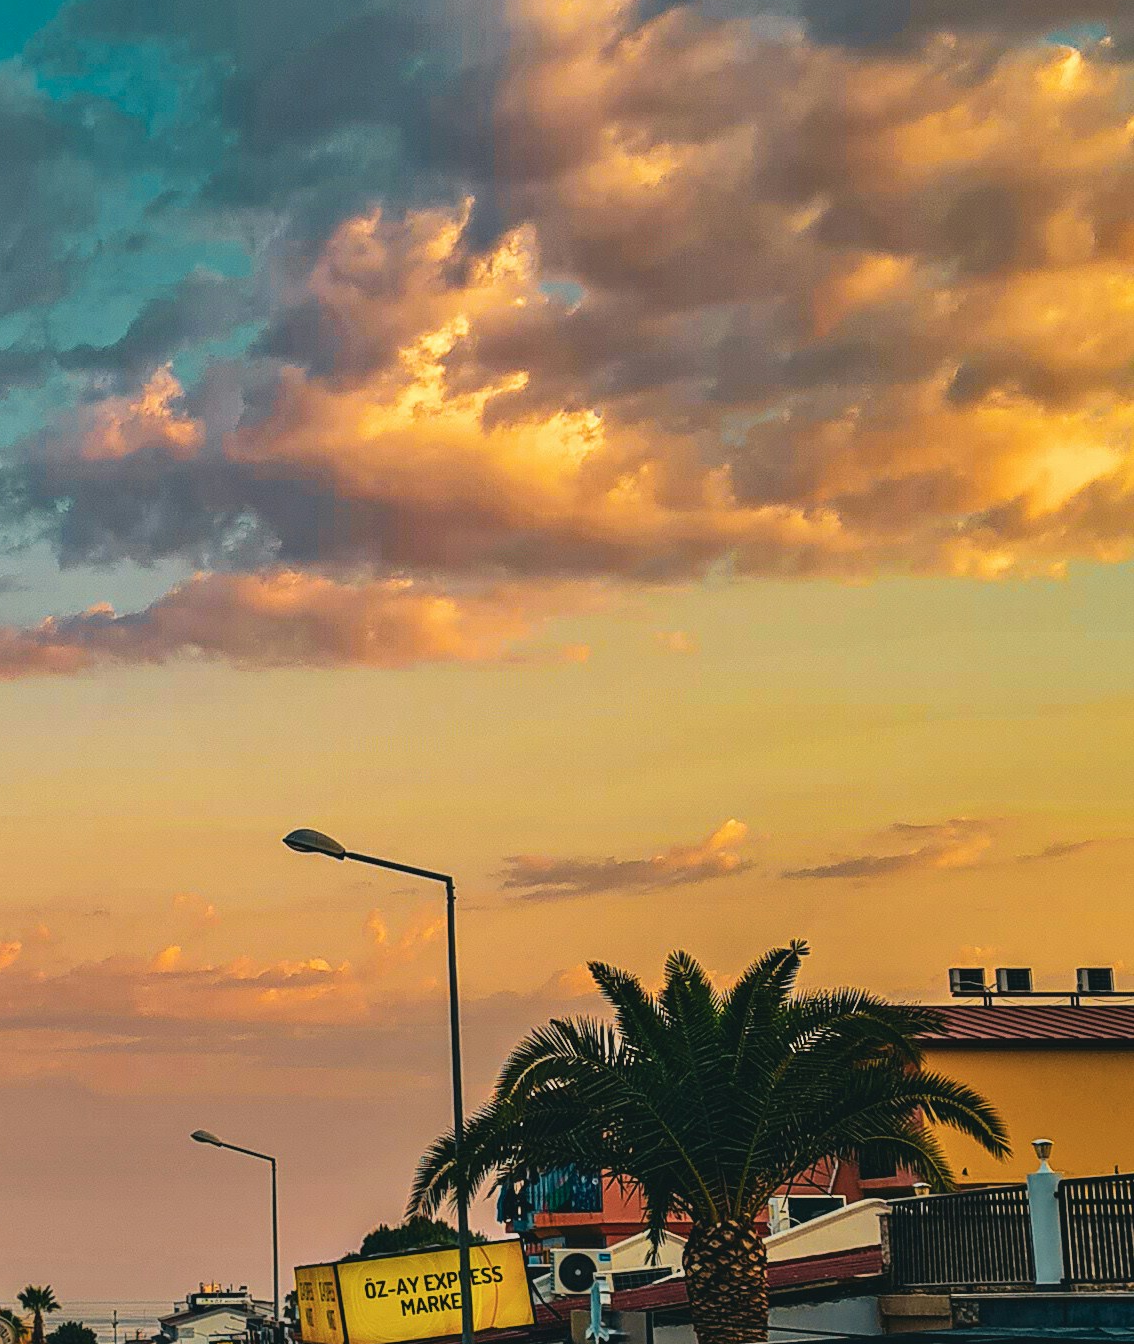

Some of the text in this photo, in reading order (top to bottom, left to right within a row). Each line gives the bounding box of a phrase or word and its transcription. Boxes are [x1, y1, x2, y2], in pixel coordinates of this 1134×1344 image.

[364, 1266, 504, 1299] ÖZ-AY EXPESS
[400, 1293, 463, 1317] MARKE
